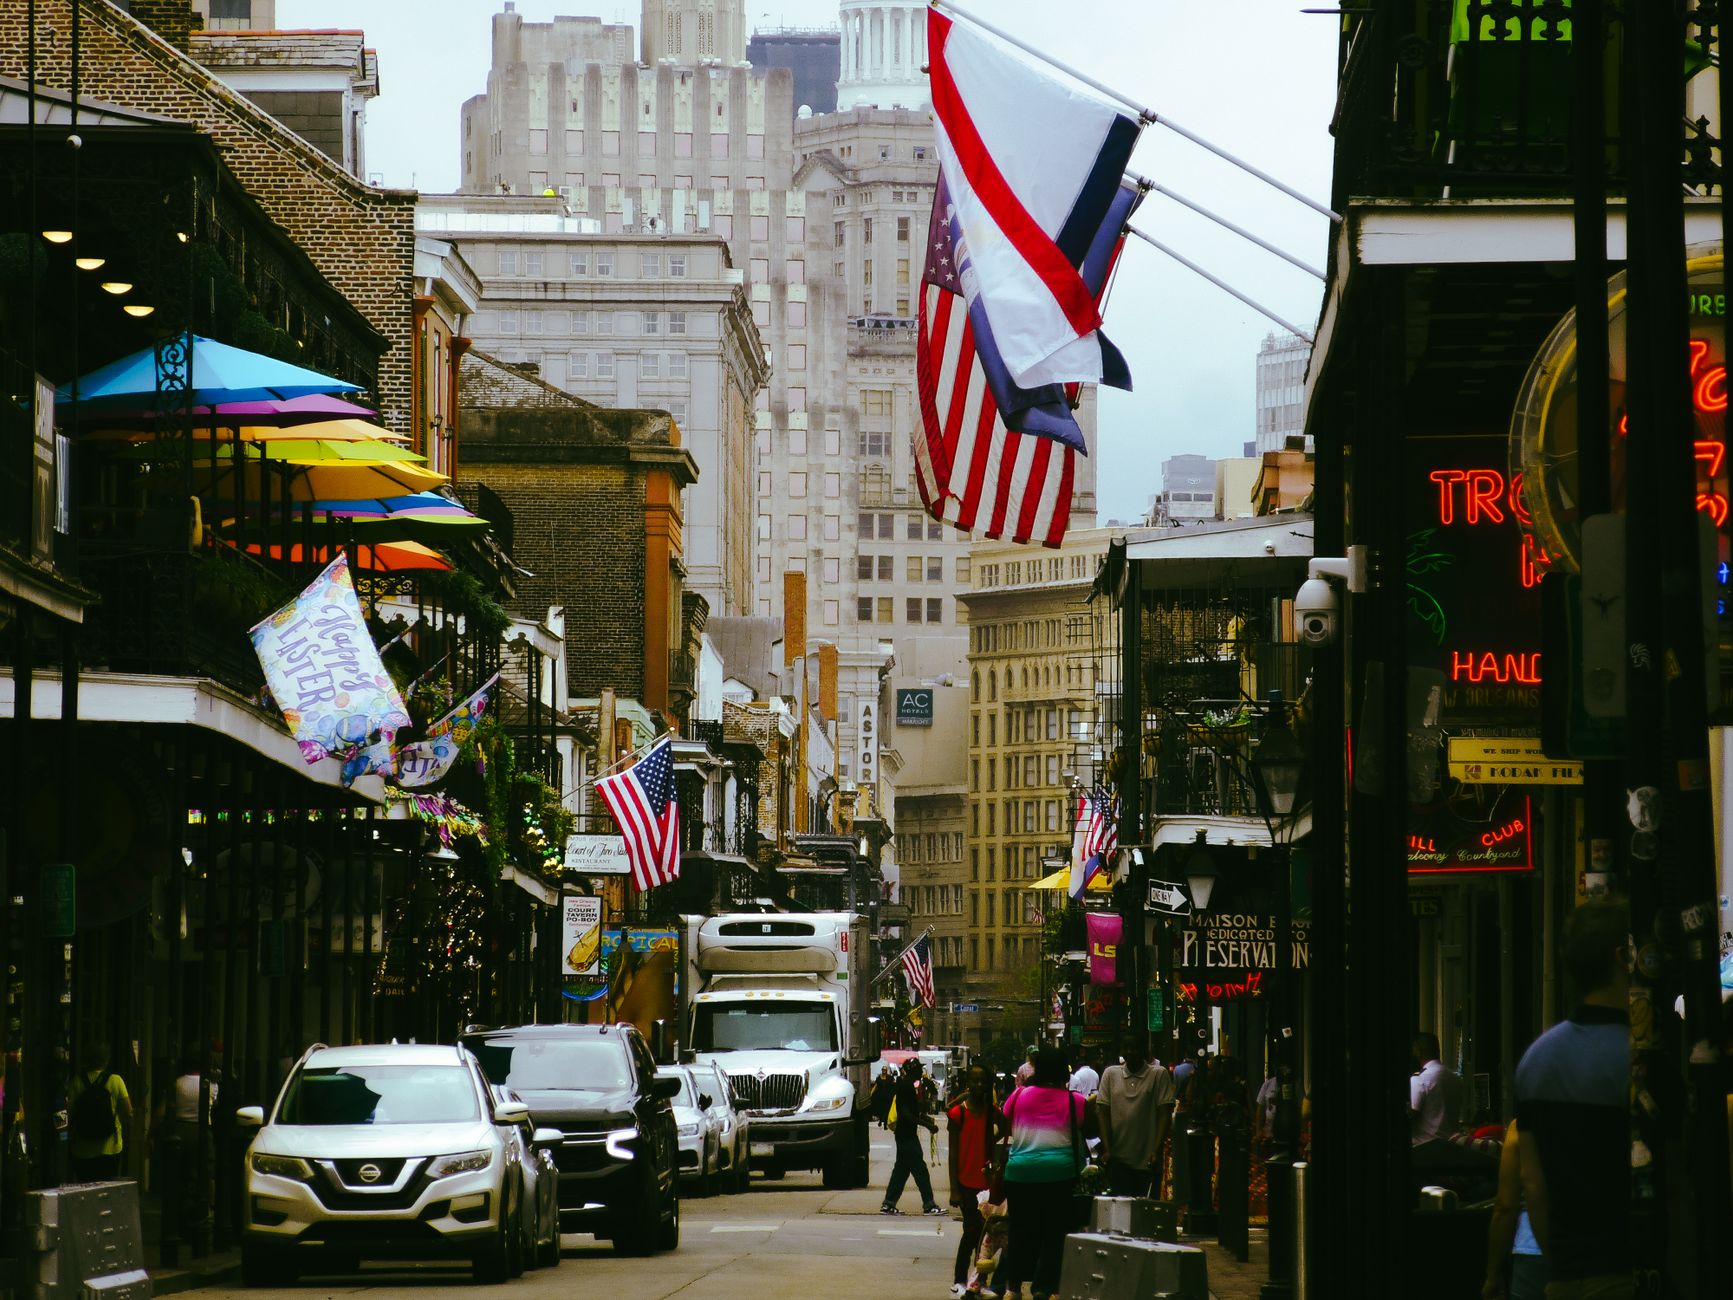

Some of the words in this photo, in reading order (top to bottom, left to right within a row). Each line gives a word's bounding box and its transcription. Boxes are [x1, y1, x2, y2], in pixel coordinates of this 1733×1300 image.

[313, 604, 384, 694] Happy
[276, 617, 337, 713] EASTER
[902, 693, 929, 708] AC
[862, 704, 873, 781] ASTOR
[1490, 767, 1544, 778] KODAK
[1480, 819, 1525, 846] CLUB
[567, 842, 587, 856] Court
[587, 844, 597, 857] of
[598, 842, 613, 857] Two
[1456, 847, 1522, 864] Courtyard
[1188, 914, 1258, 928] MAISON
